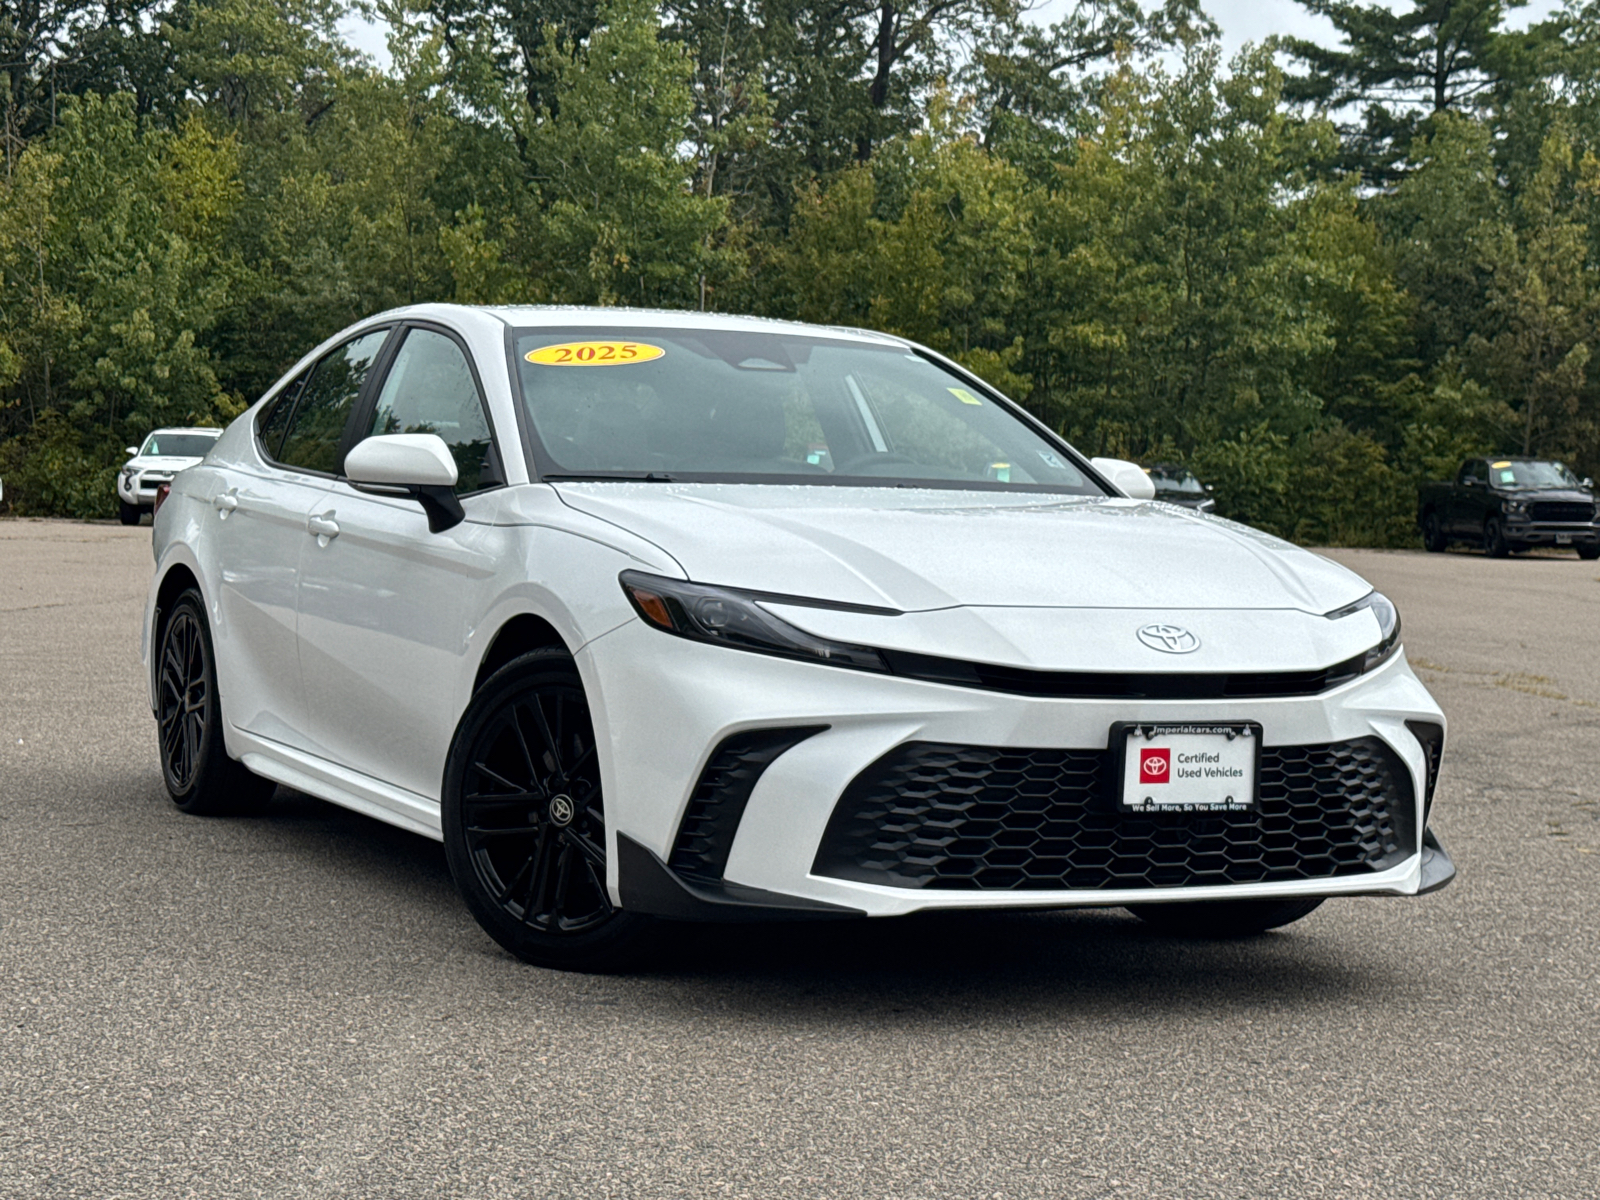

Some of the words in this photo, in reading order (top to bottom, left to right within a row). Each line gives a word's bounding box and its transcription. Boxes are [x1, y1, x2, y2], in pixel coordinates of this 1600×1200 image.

[554, 344, 638, 363] 2025
[1177, 752, 1220, 764] Certified
[1177, 767, 1202, 778] Used
[1204, 766, 1243, 778] Vehicles
[1194, 803, 1209, 811] You
